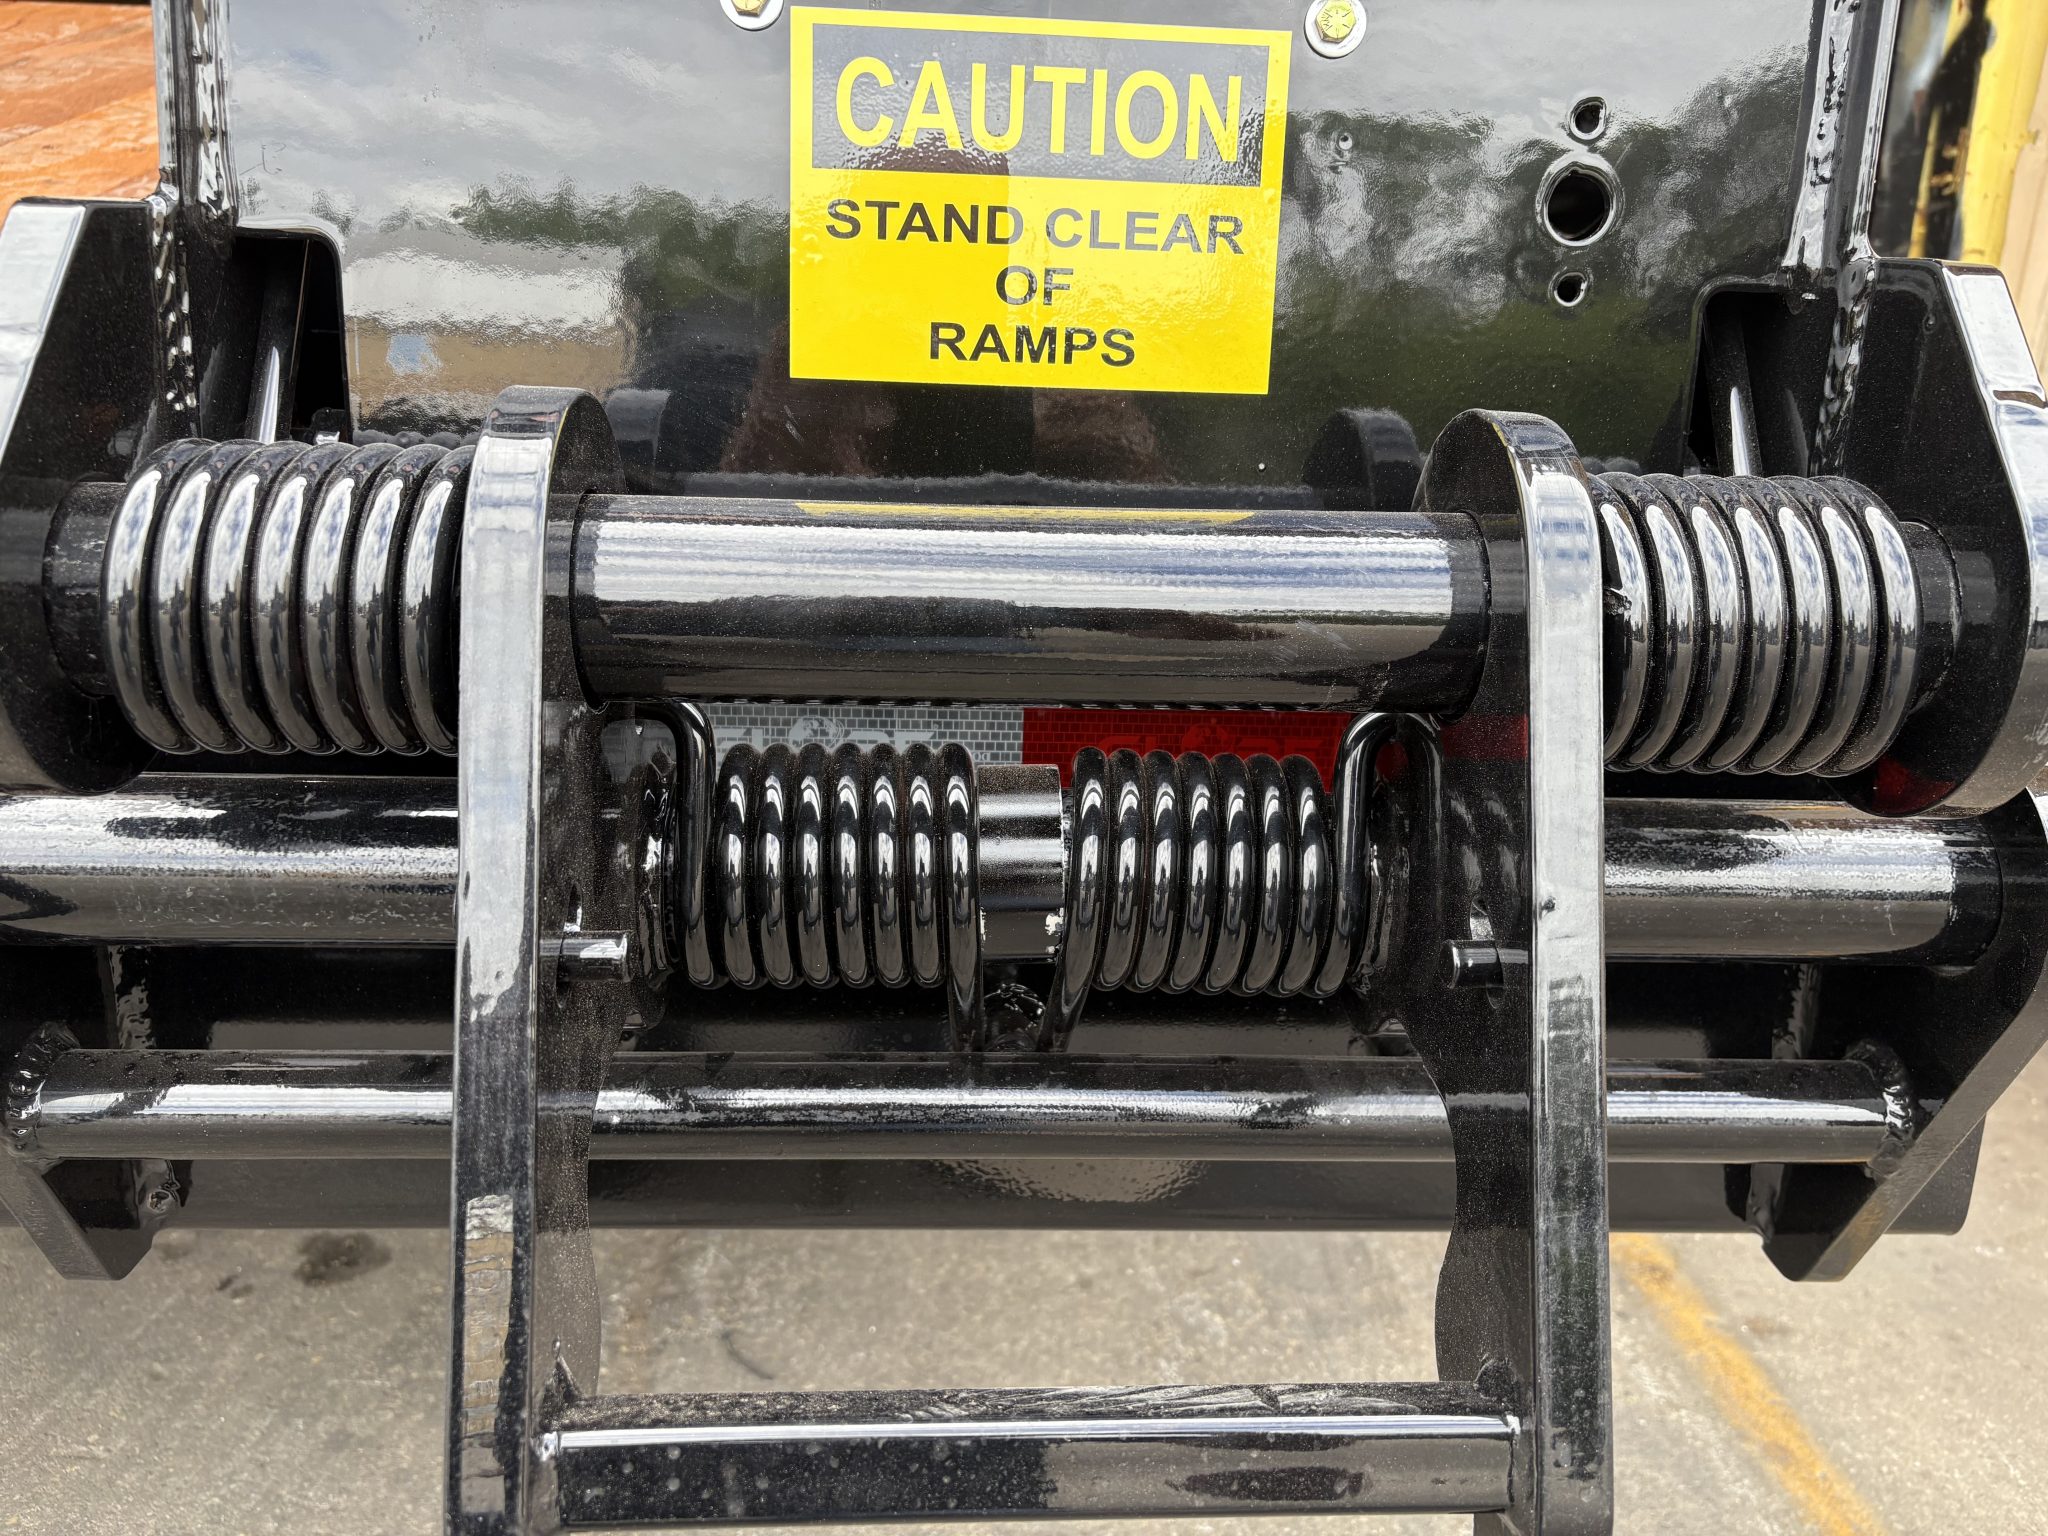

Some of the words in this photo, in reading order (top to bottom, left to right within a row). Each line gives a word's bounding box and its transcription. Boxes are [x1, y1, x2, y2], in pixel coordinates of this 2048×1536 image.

[835, 56, 1242, 163] CAUTION
[825, 198, 1024, 246] STAND
[1045, 206, 1245, 255] CLEAR
[995, 264, 1075, 307] OF
[929, 320, 1137, 368] RAMPS
